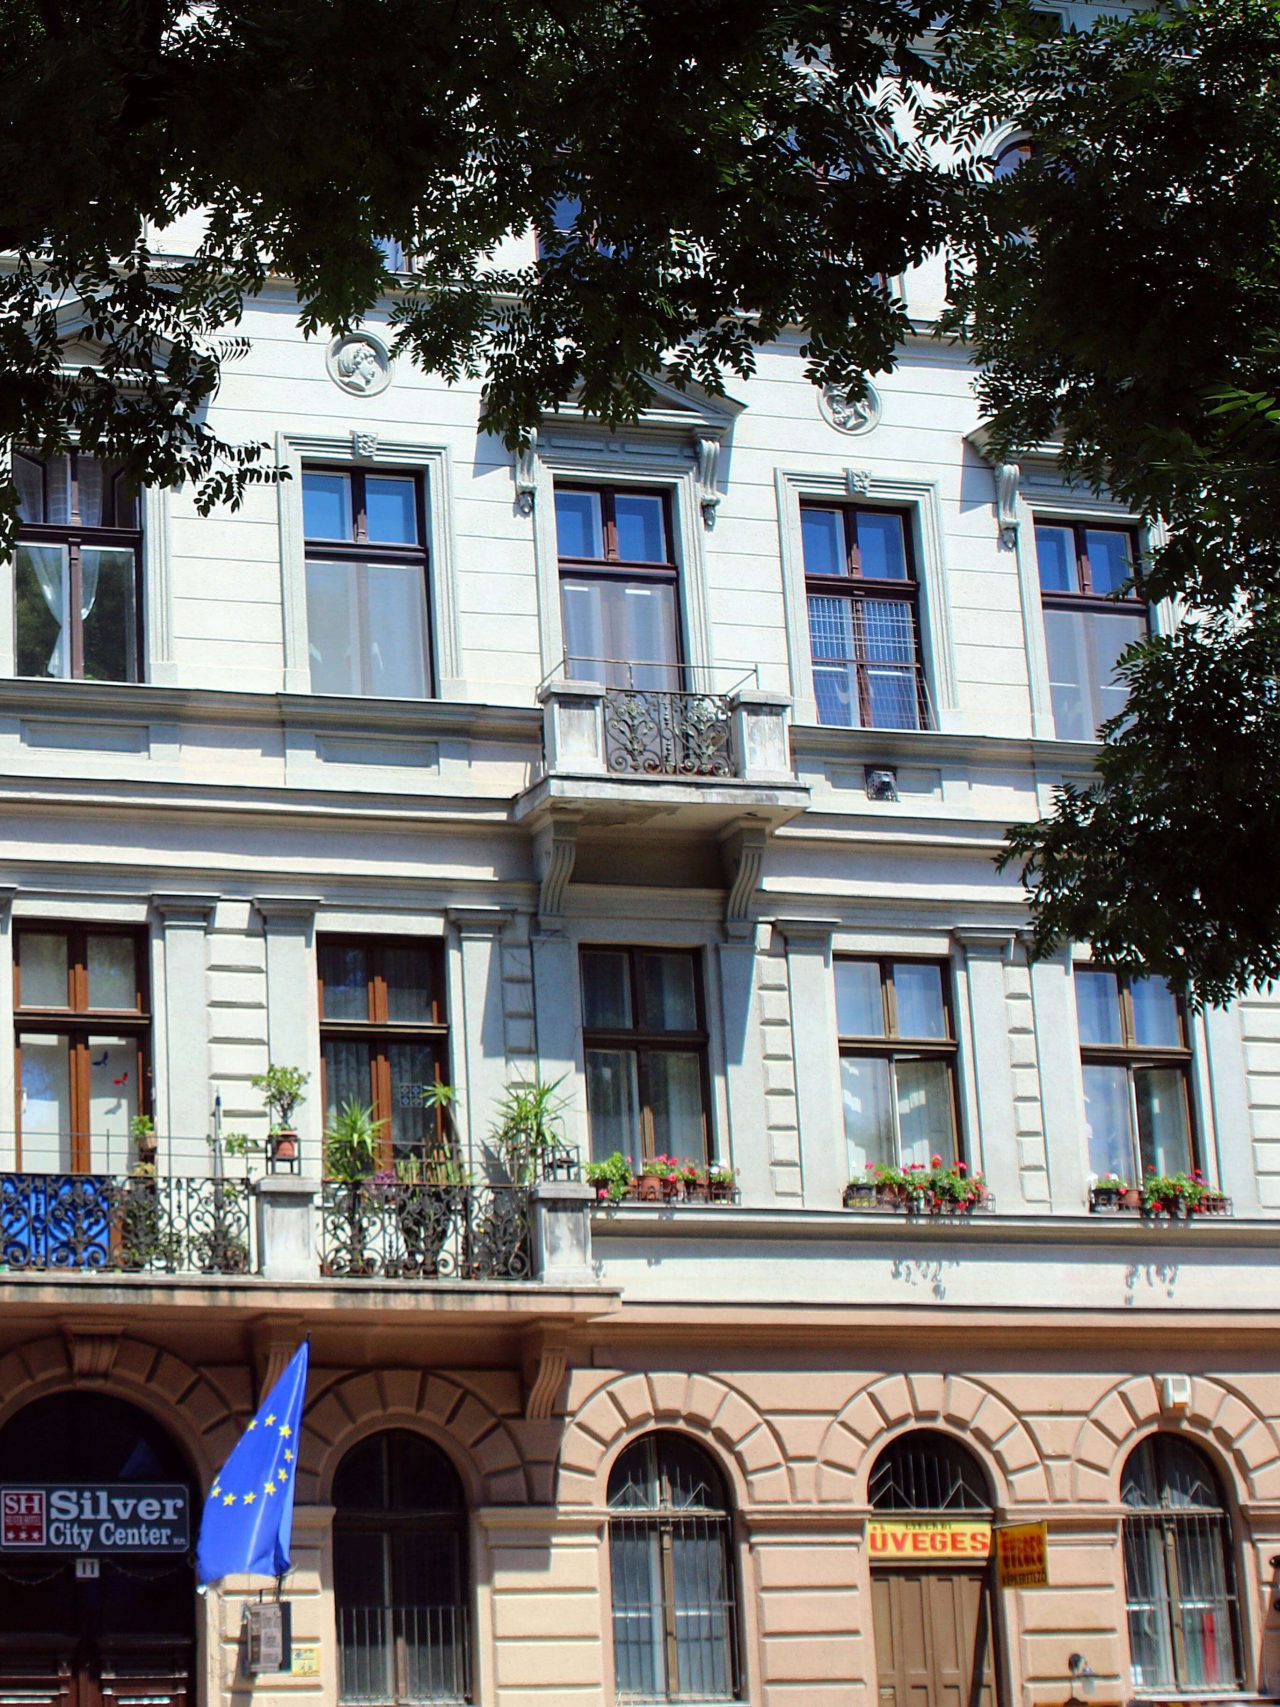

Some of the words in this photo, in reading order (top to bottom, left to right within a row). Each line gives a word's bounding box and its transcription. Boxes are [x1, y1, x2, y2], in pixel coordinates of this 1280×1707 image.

[5, 1495, 41, 1515] SH
[50, 1490, 185, 1520] Silver
[49, 1522, 94, 1550] City
[99, 1522, 171, 1546] Center
[869, 1525, 989, 1553] ÜVEGES
